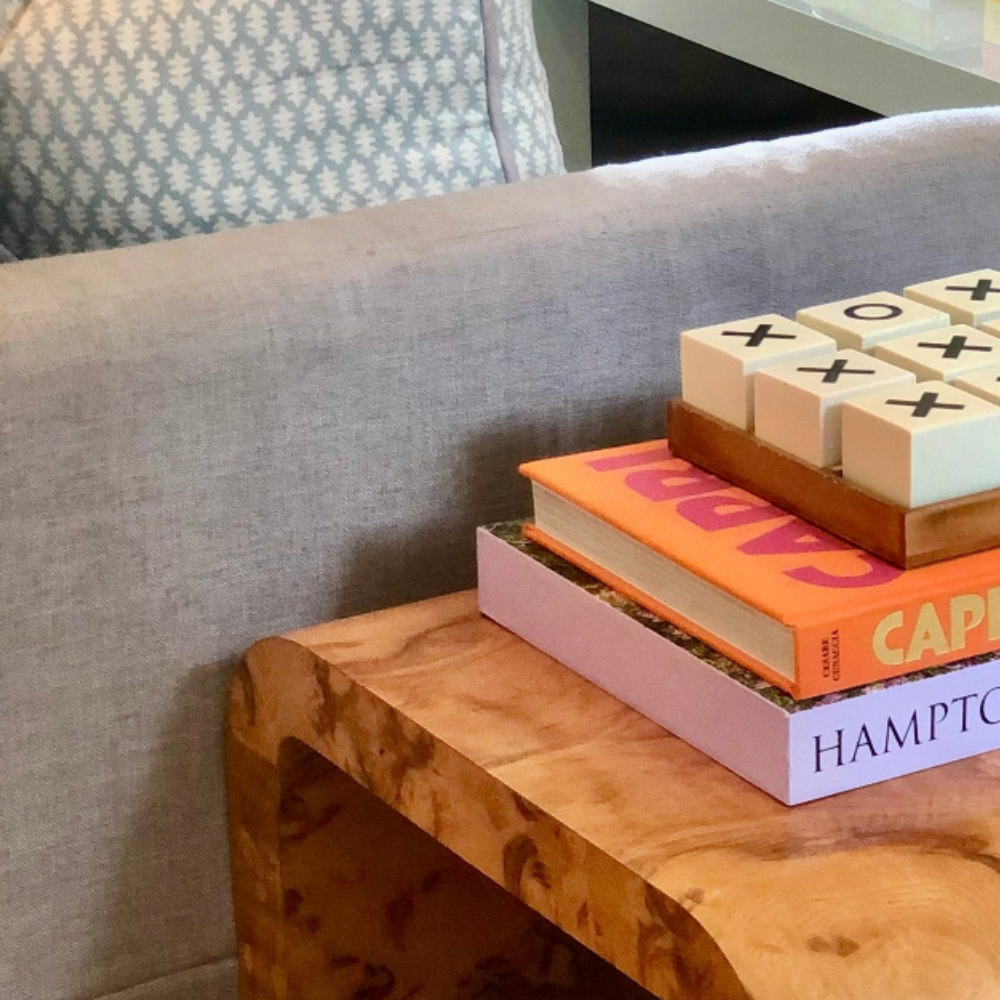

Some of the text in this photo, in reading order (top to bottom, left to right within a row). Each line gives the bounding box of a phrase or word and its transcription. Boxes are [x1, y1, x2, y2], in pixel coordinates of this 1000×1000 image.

[843, 303, 903, 320] O
[721, 323, 797, 347] X
[917, 335, 992, 359] X
[796, 358, 876, 383] X
[885, 391, 965, 418] X
